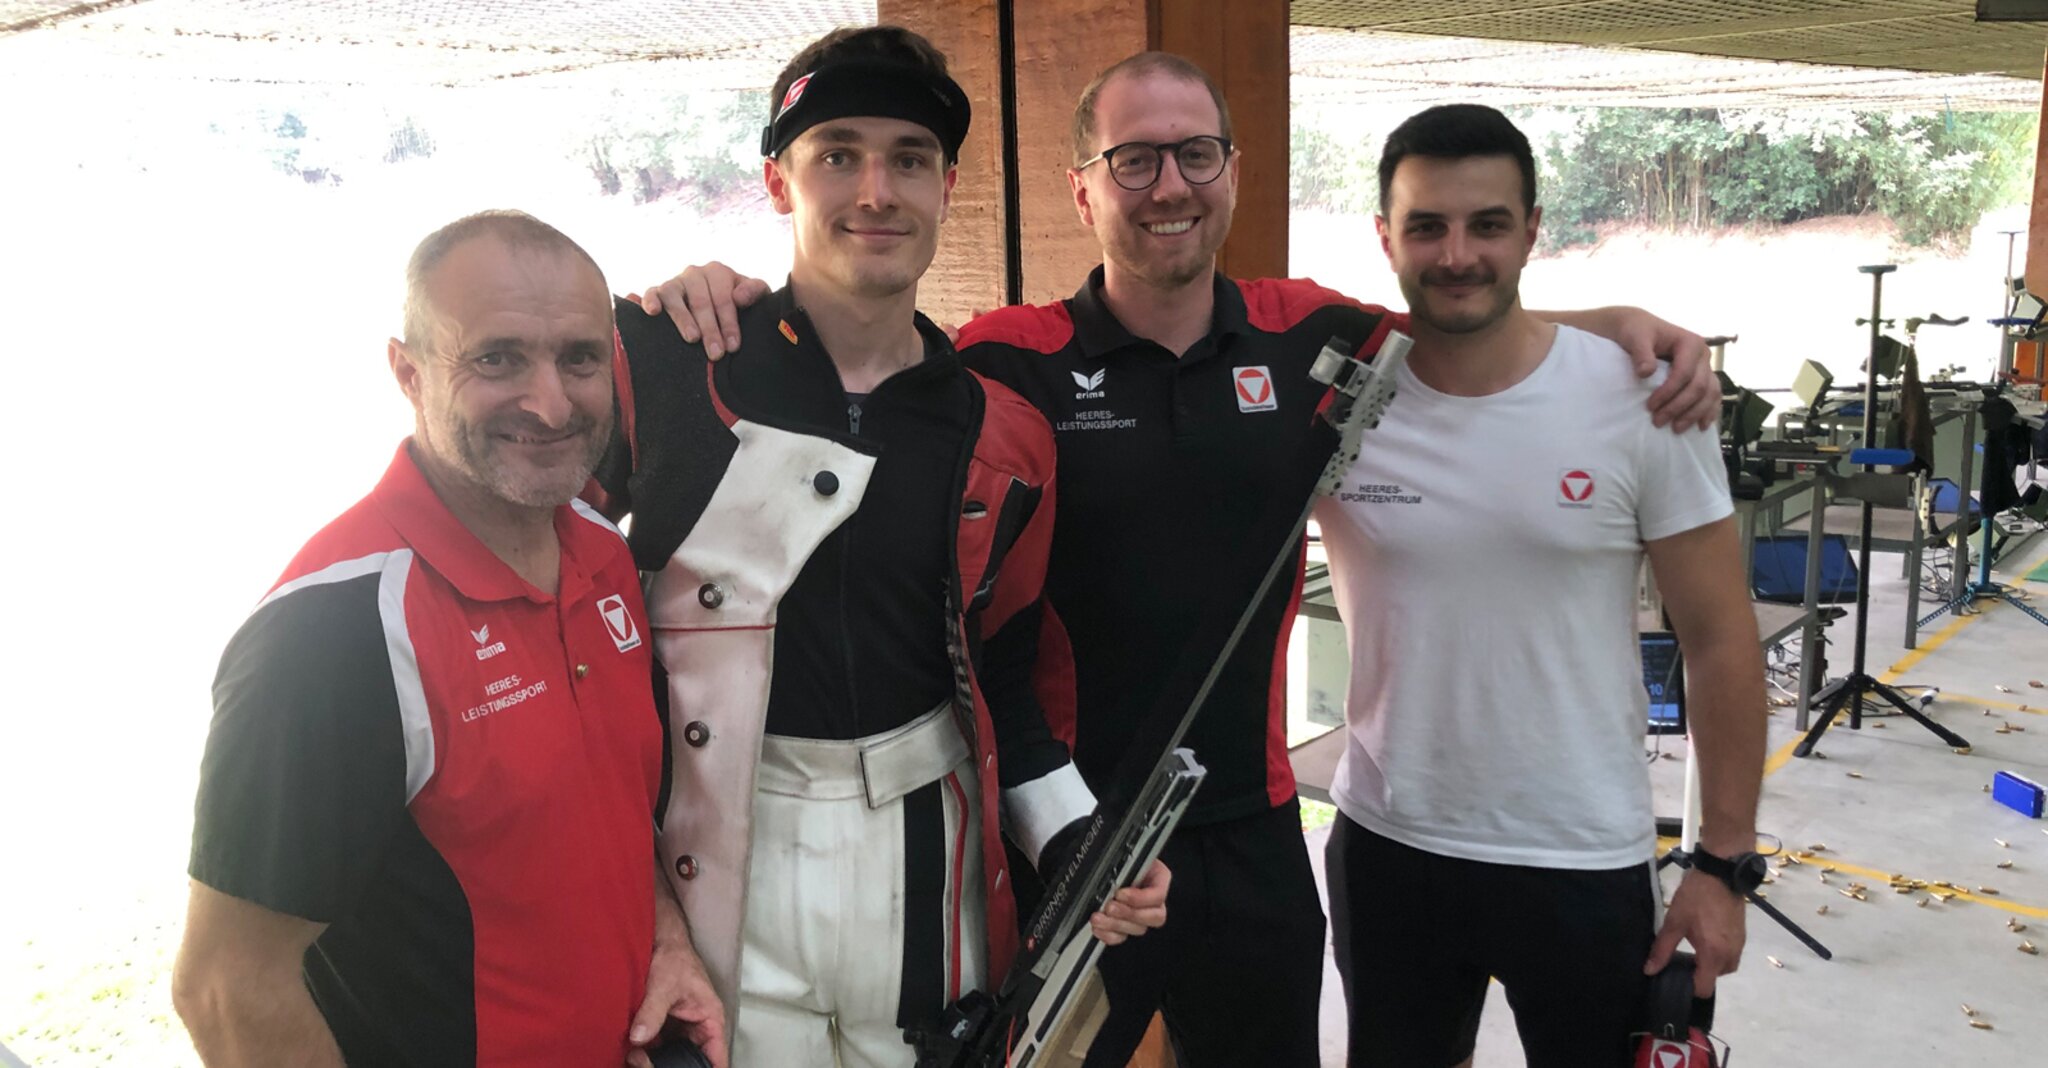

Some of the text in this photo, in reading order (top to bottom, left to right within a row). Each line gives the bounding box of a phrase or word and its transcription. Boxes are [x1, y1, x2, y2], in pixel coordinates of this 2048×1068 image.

[1075, 390, 1105, 399] erima
[1075, 410, 1115, 420] HEERES-
[1056, 418, 1137, 430] LEISTUNGSSPORT
[1358, 484, 1402, 494] HEERES-
[1340, 492, 1422, 504] SPORTZENTRUM
[475, 641, 506, 660] erima
[484, 674, 522, 696] HEERES-
[461, 680, 547, 722] LEISTUNGSSPORT
